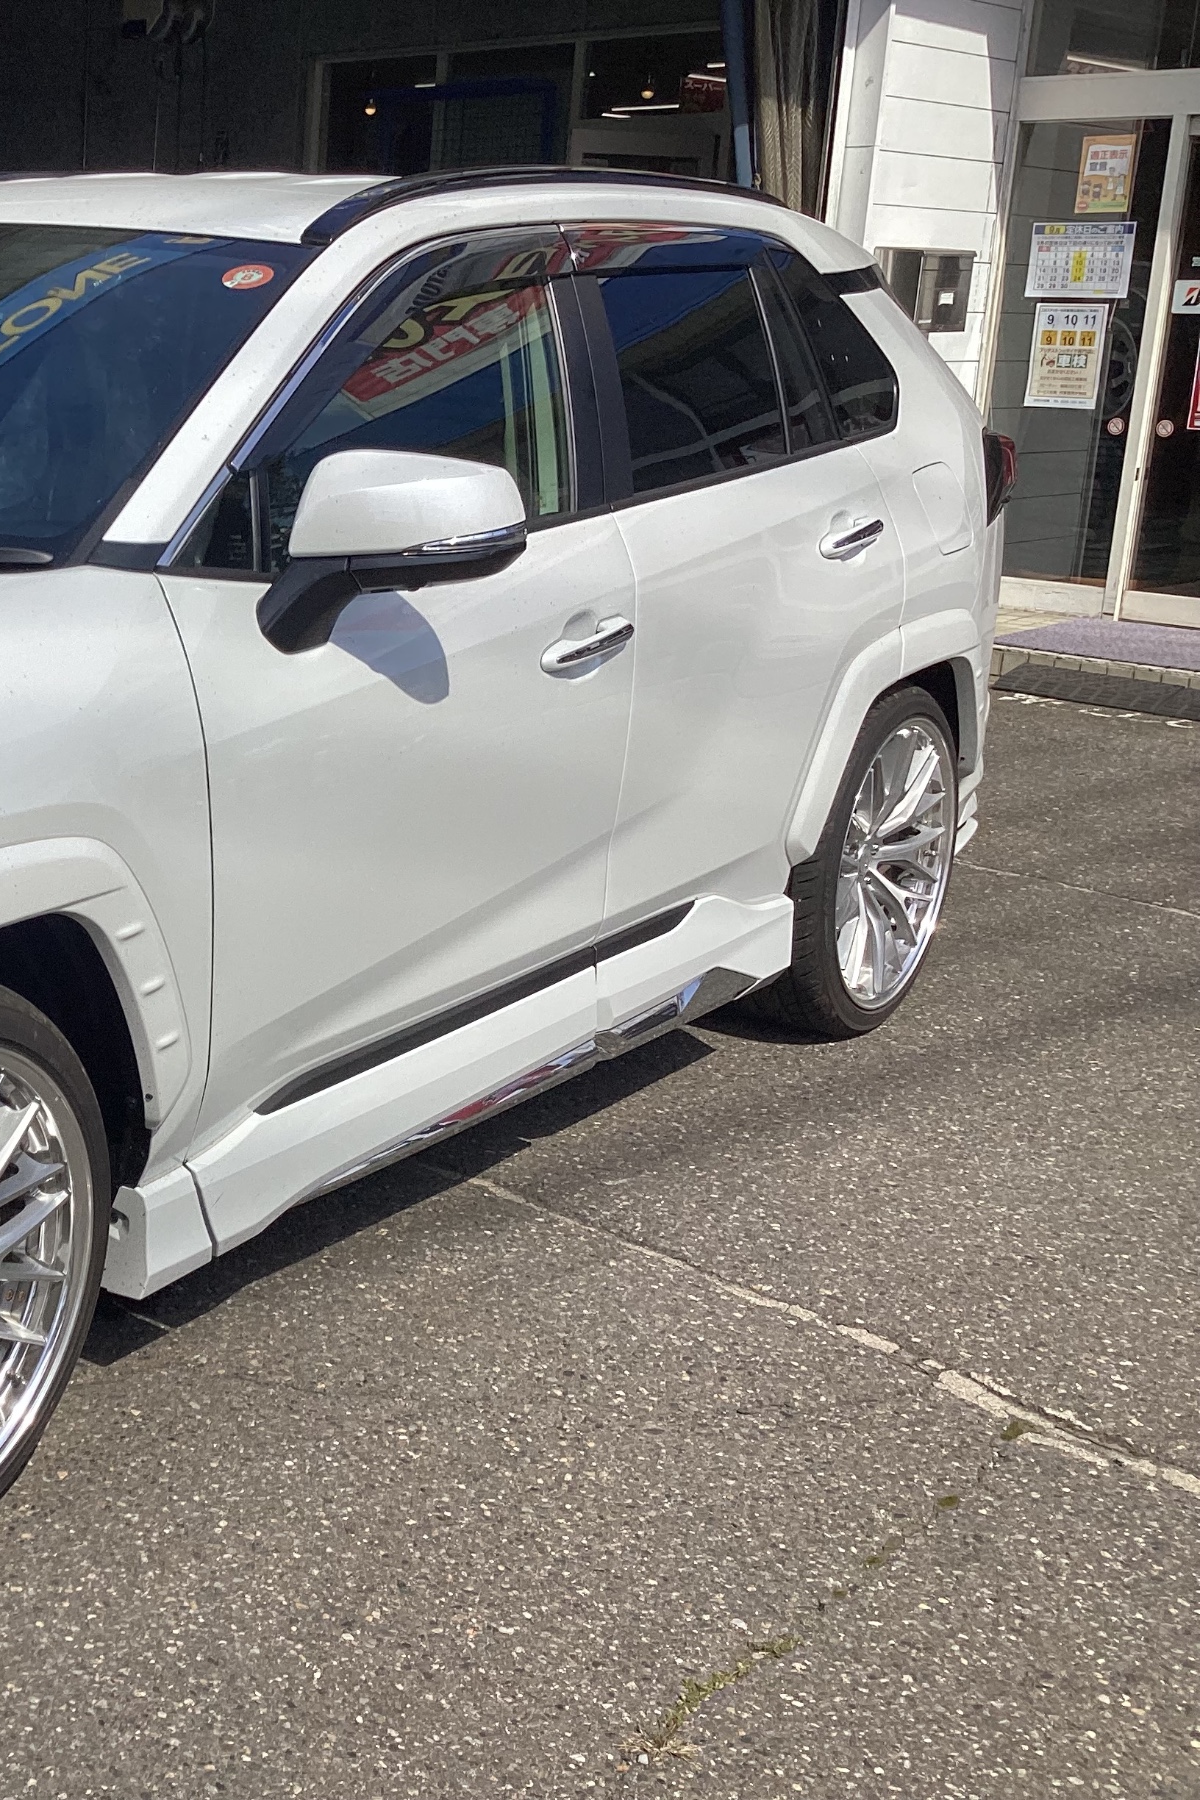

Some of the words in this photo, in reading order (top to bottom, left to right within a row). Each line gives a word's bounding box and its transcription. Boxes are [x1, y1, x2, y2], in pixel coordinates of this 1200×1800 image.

[1065, 225, 1125, 234] 定休日のご案内
[1047, 314, 1055, 325] 9
[1064, 314, 1078, 326] 10
[1084, 314, 1097, 326] 11
[1046, 335, 1052, 345] 9
[1062, 336, 1075, 346] 10
[1081, 337, 1092, 346] 11
[1057, 355, 1087, 368] 車検
